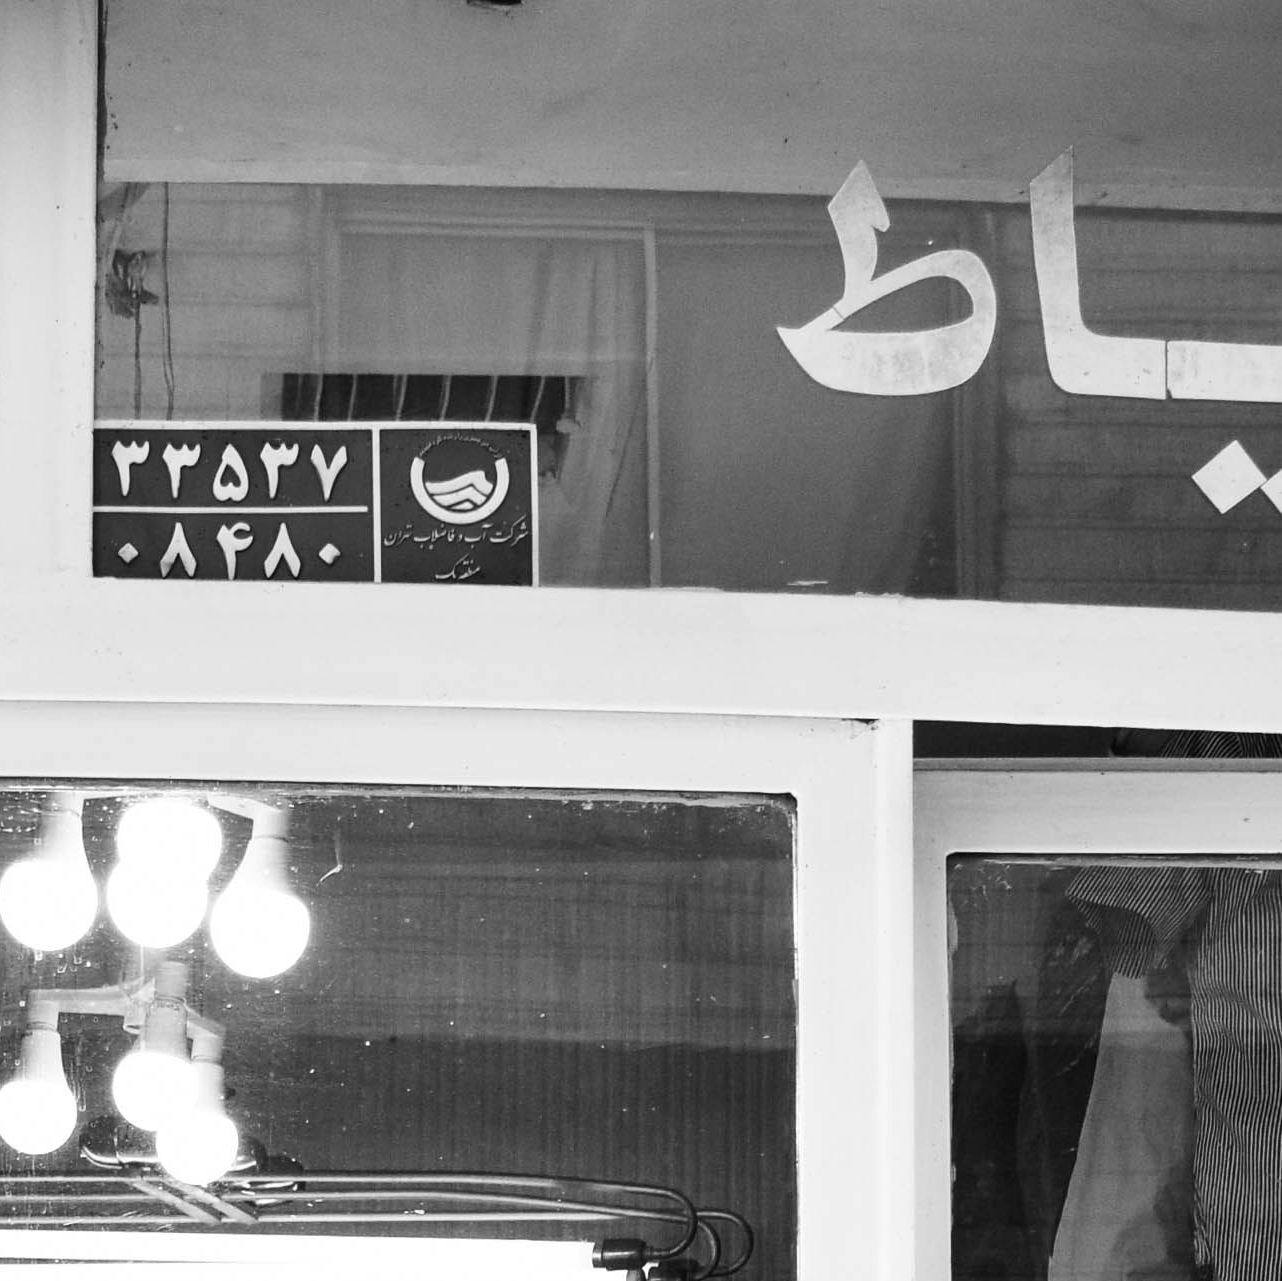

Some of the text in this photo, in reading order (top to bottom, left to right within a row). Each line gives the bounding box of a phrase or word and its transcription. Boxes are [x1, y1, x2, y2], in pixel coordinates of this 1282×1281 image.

[111, 440, 348, 501] ۳۳۵۳۷
[383, 524, 413, 546] تهران
[464, 523, 493, 549] آب
[489, 514, 529, 547] شرکت
[117, 522, 341, 580] ۰۸۴۸۰
